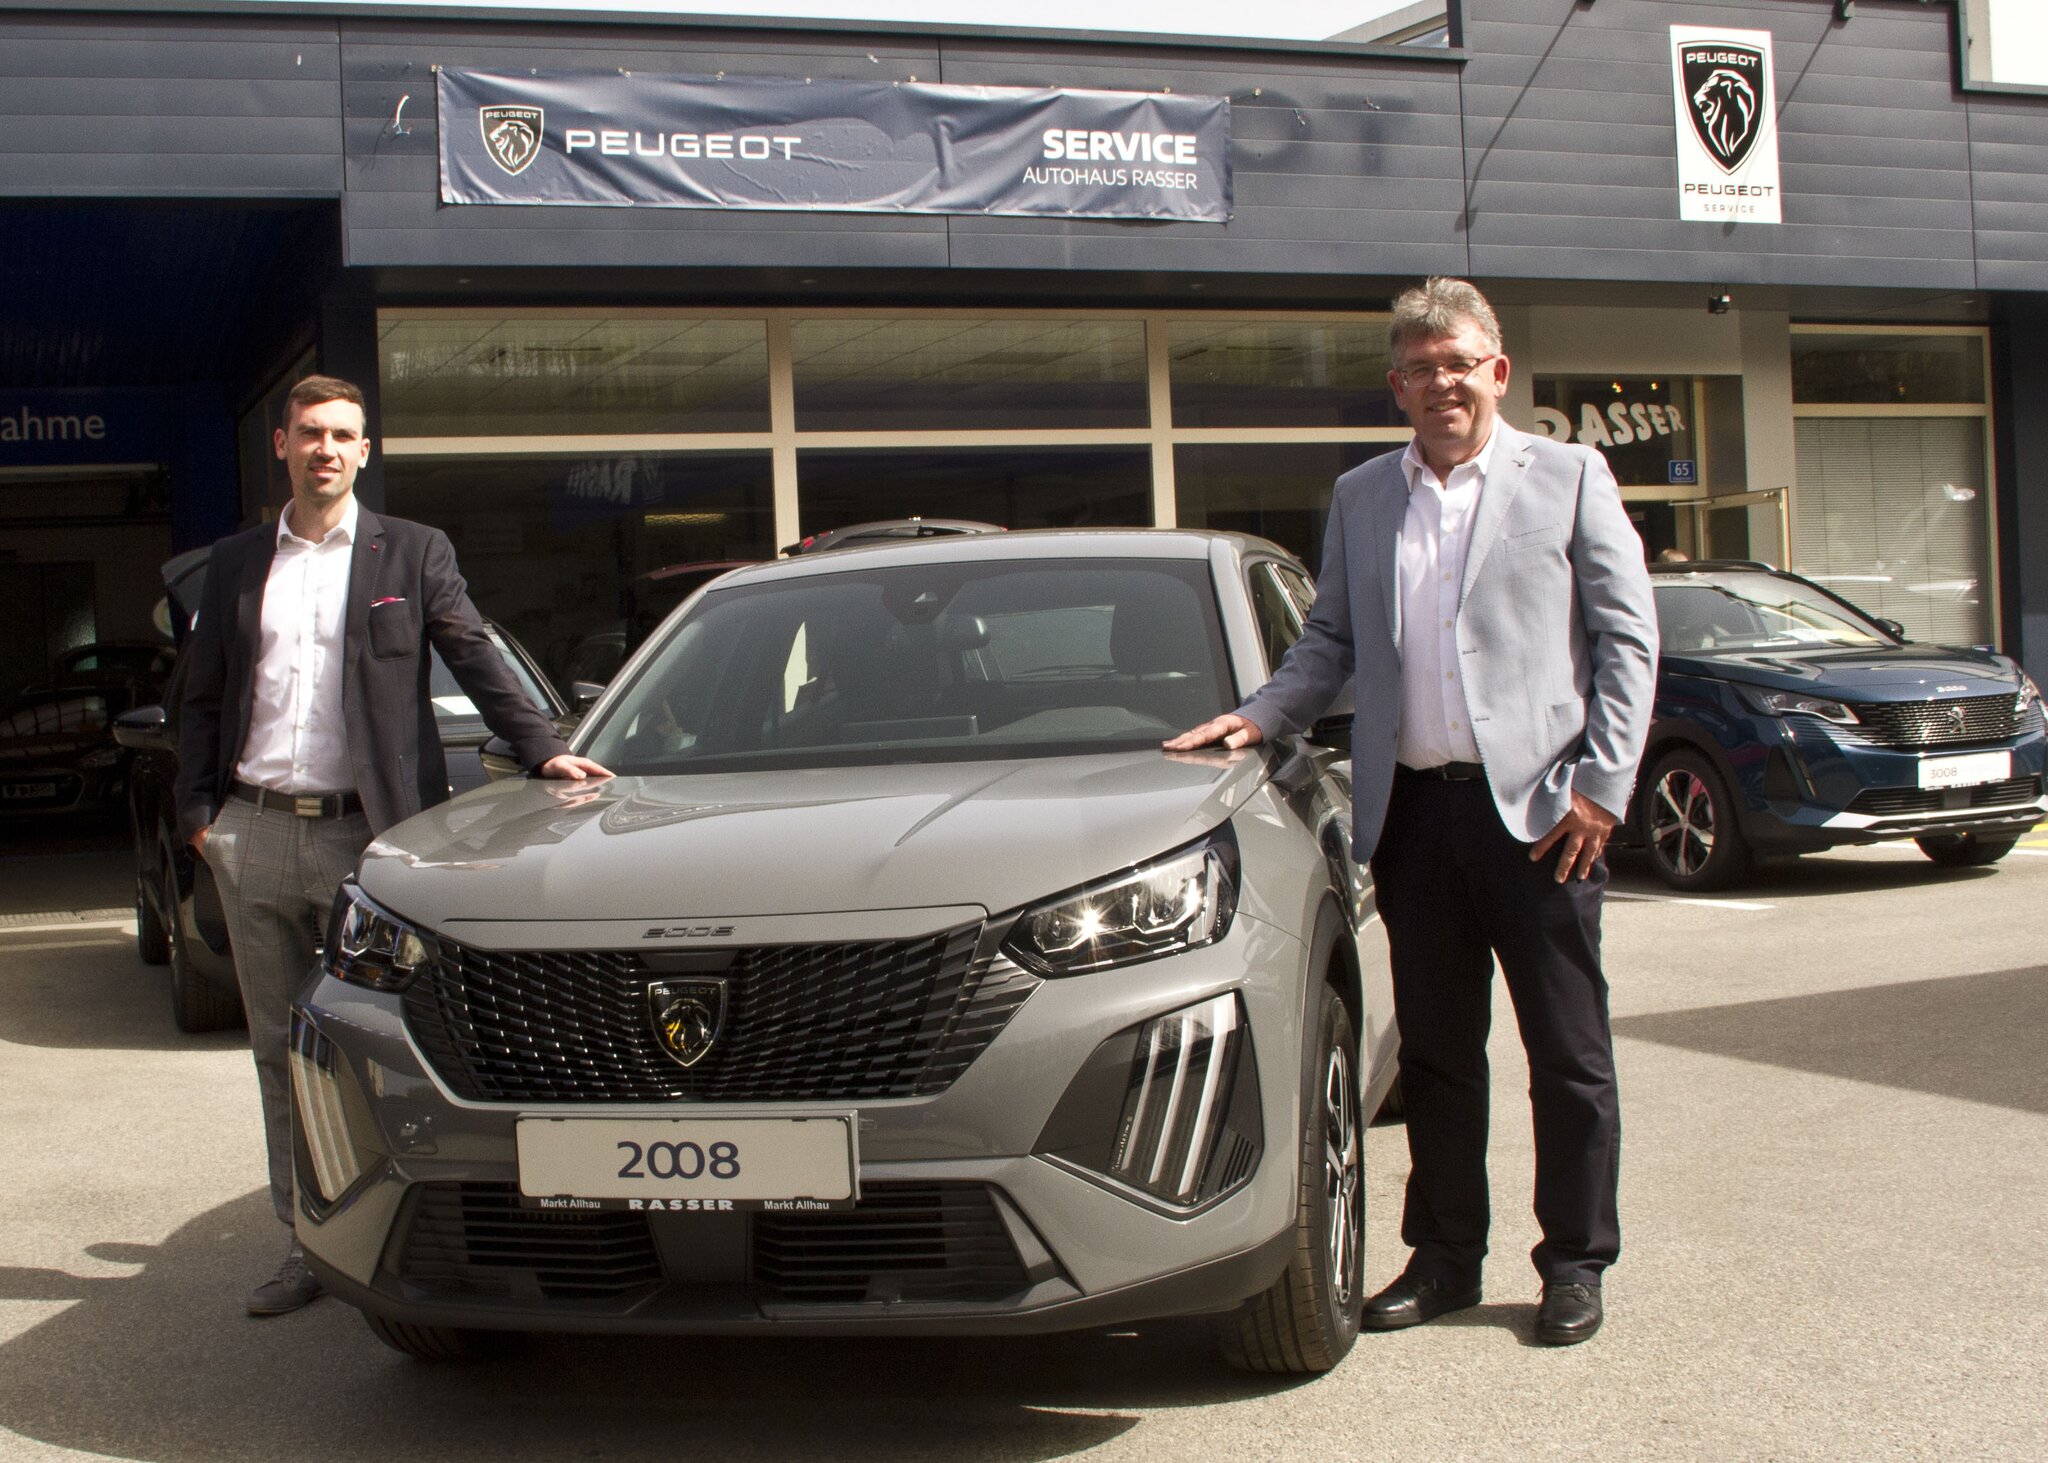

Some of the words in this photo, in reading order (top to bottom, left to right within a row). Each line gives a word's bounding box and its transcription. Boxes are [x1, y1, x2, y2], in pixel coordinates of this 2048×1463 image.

[1686, 52, 1758, 67] PEUGEOT
[485, 111, 538, 120] PEUGEOT
[565, 129, 801, 161] PEUGEOT
[1042, 129, 1197, 165] SERVICE
[1022, 166, 1127, 186] AUTOHAUS
[1132, 170, 1198, 190] RASSER
[1684, 183, 1774, 197] PEUGEOT
[1704, 204, 1756, 214] SERVICE
[0, 405, 106, 441] ahme
[1675, 463, 1689, 476] 65
[1929, 767, 1958, 779] 3008
[654, 986, 716, 996] PEUGEOT
[616, 1141, 741, 1180] 2008
[540, 1198, 568, 1209] Markt
[569, 1198, 601, 1210] Allhau
[629, 1199, 734, 1211] RASSER
[764, 1200, 794, 1211] Markt
[796, 1200, 830, 1211] Allhau
